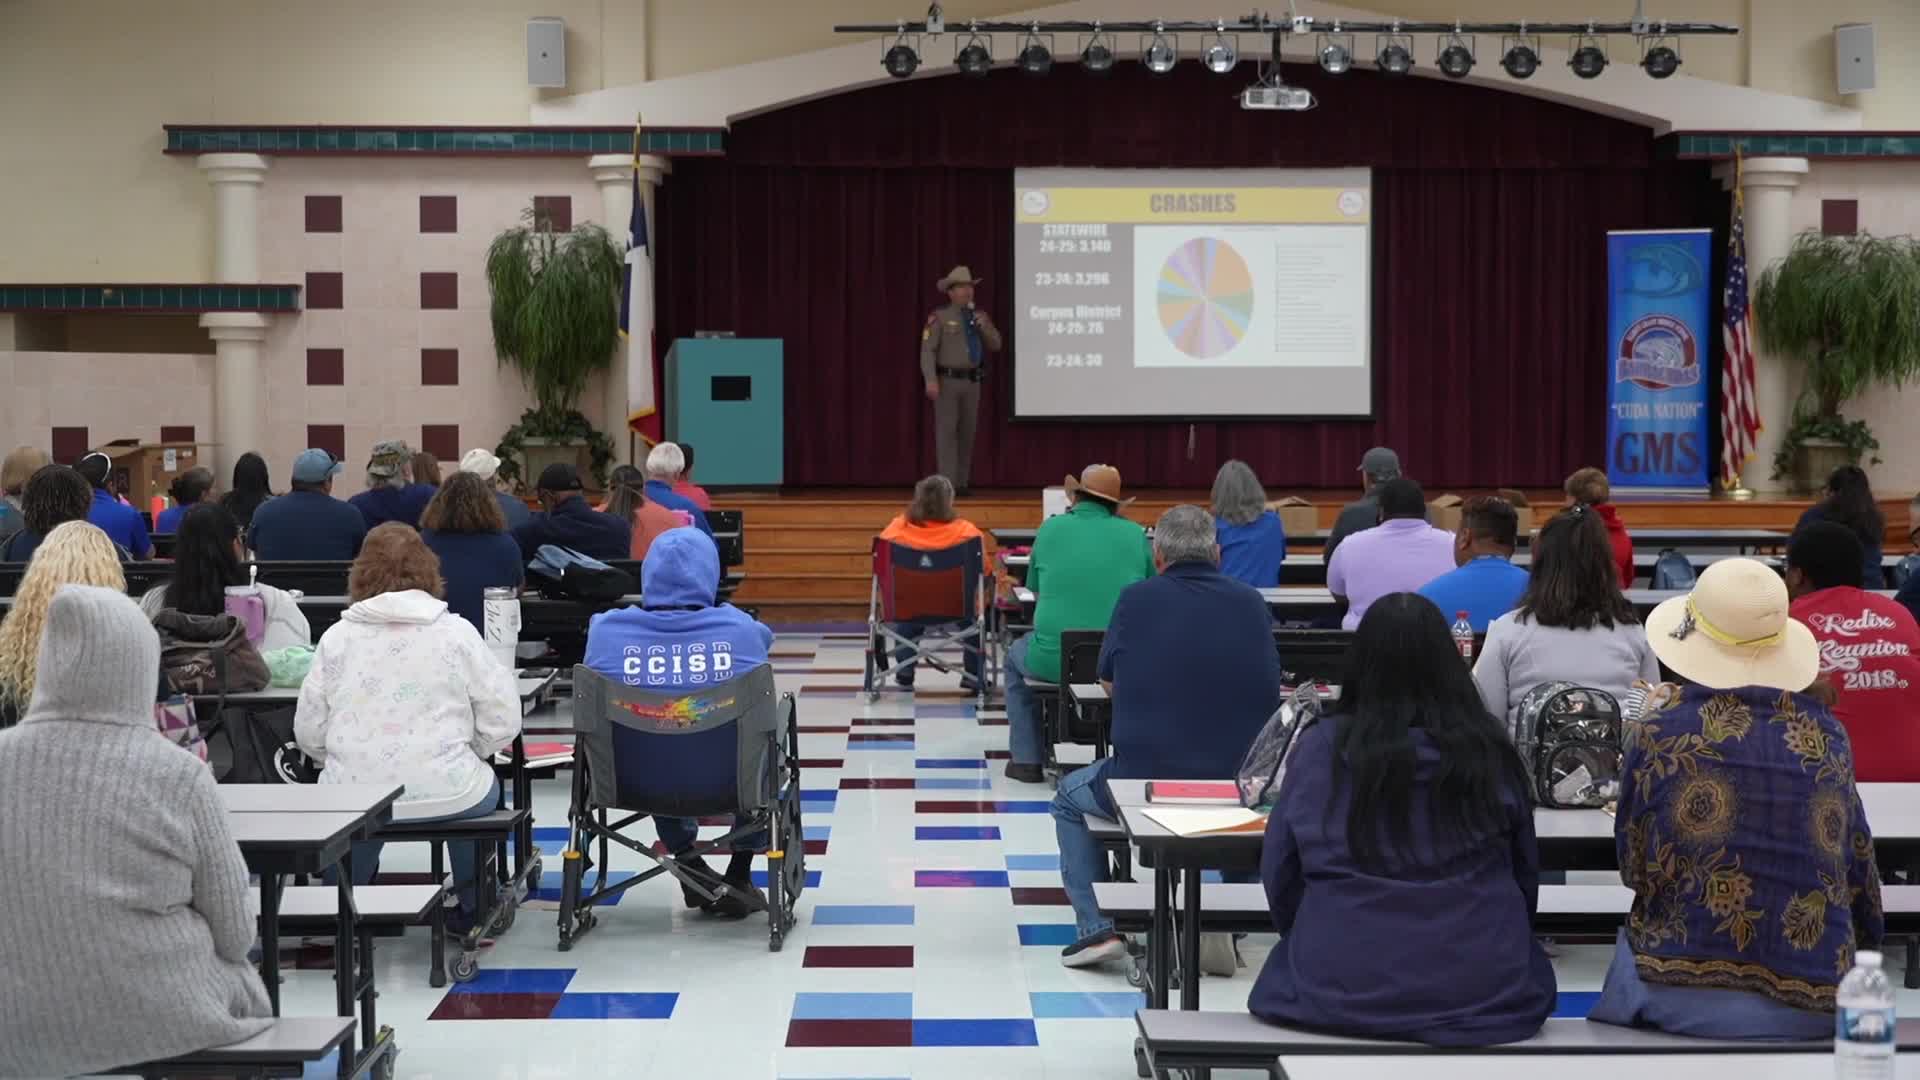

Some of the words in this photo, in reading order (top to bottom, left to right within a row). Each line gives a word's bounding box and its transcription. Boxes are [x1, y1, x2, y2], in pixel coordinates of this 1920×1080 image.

[1151, 193, 1236, 213] CRASHES
[1042, 223, 1107, 237] STATEWIDE
[1615, 432, 1701, 475] GMS
[1823, 608, 1896, 637] Redix
[623, 652, 734, 675] CCISD
[1817, 638, 1910, 671] Reunion
[1843, 669, 1897, 690] 2018
